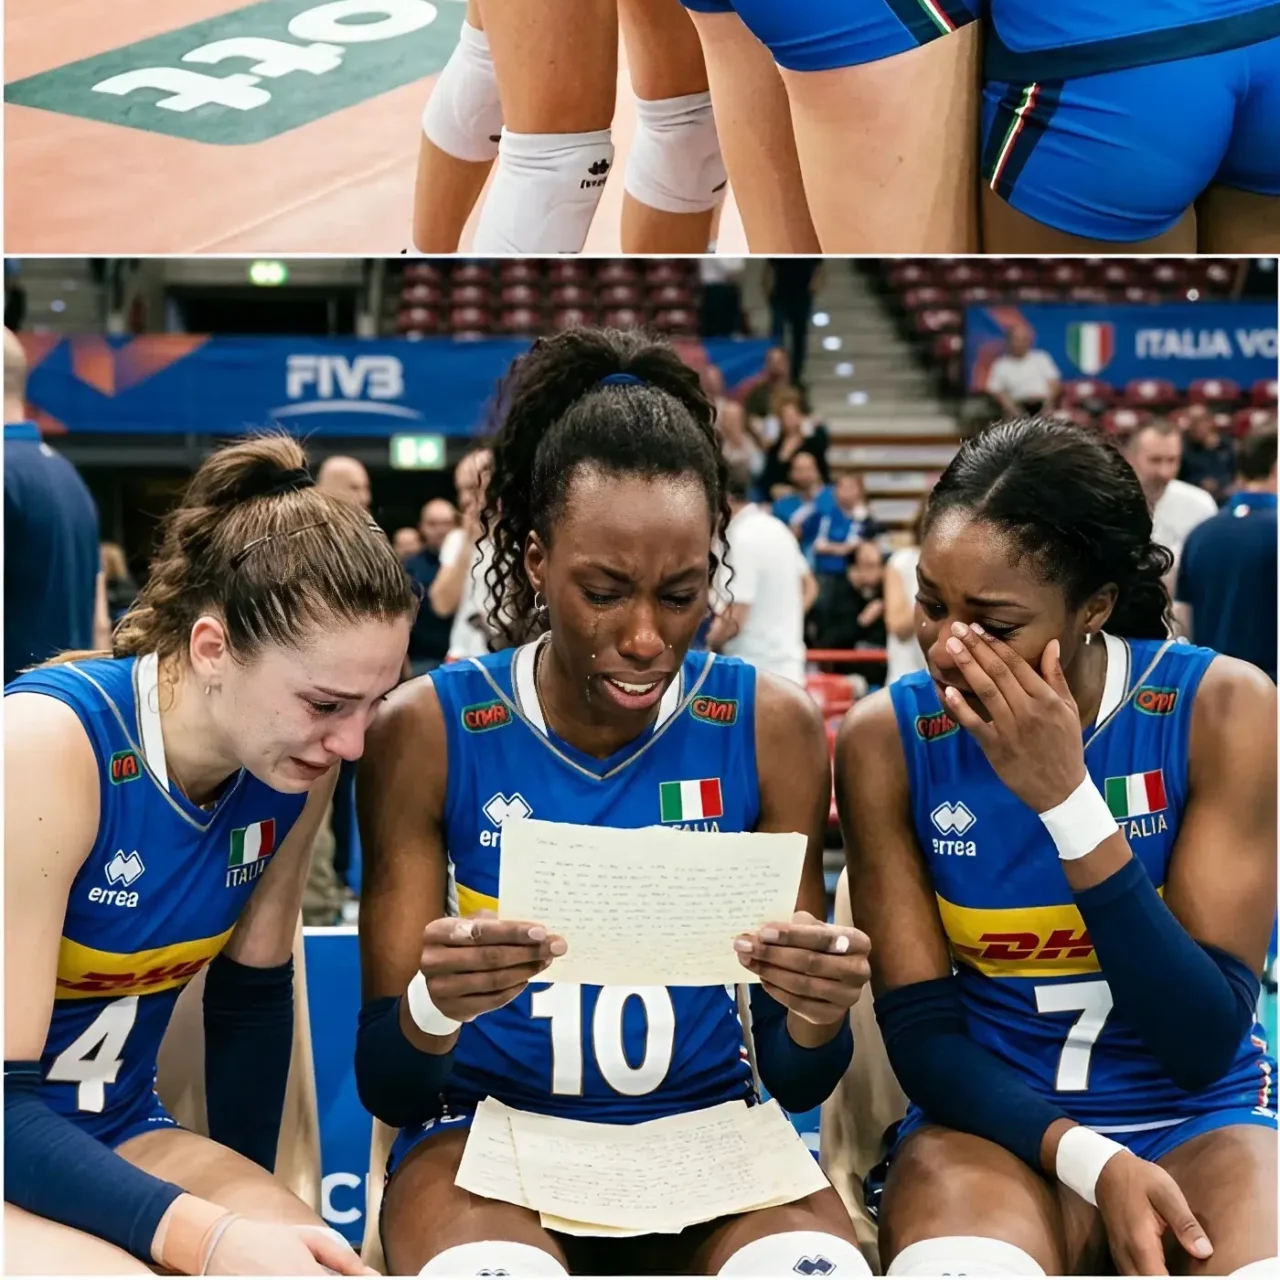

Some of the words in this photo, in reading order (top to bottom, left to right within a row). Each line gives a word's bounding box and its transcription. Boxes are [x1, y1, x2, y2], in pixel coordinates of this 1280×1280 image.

[286, 355, 404, 399] FIVB
[1135, 328, 1232, 360] ITALIA
[977, 928, 1094, 961] DH
[45, 995, 139, 1113] 4
[528, 982, 675, 1097] 10
[1033, 979, 1114, 1092] 7
